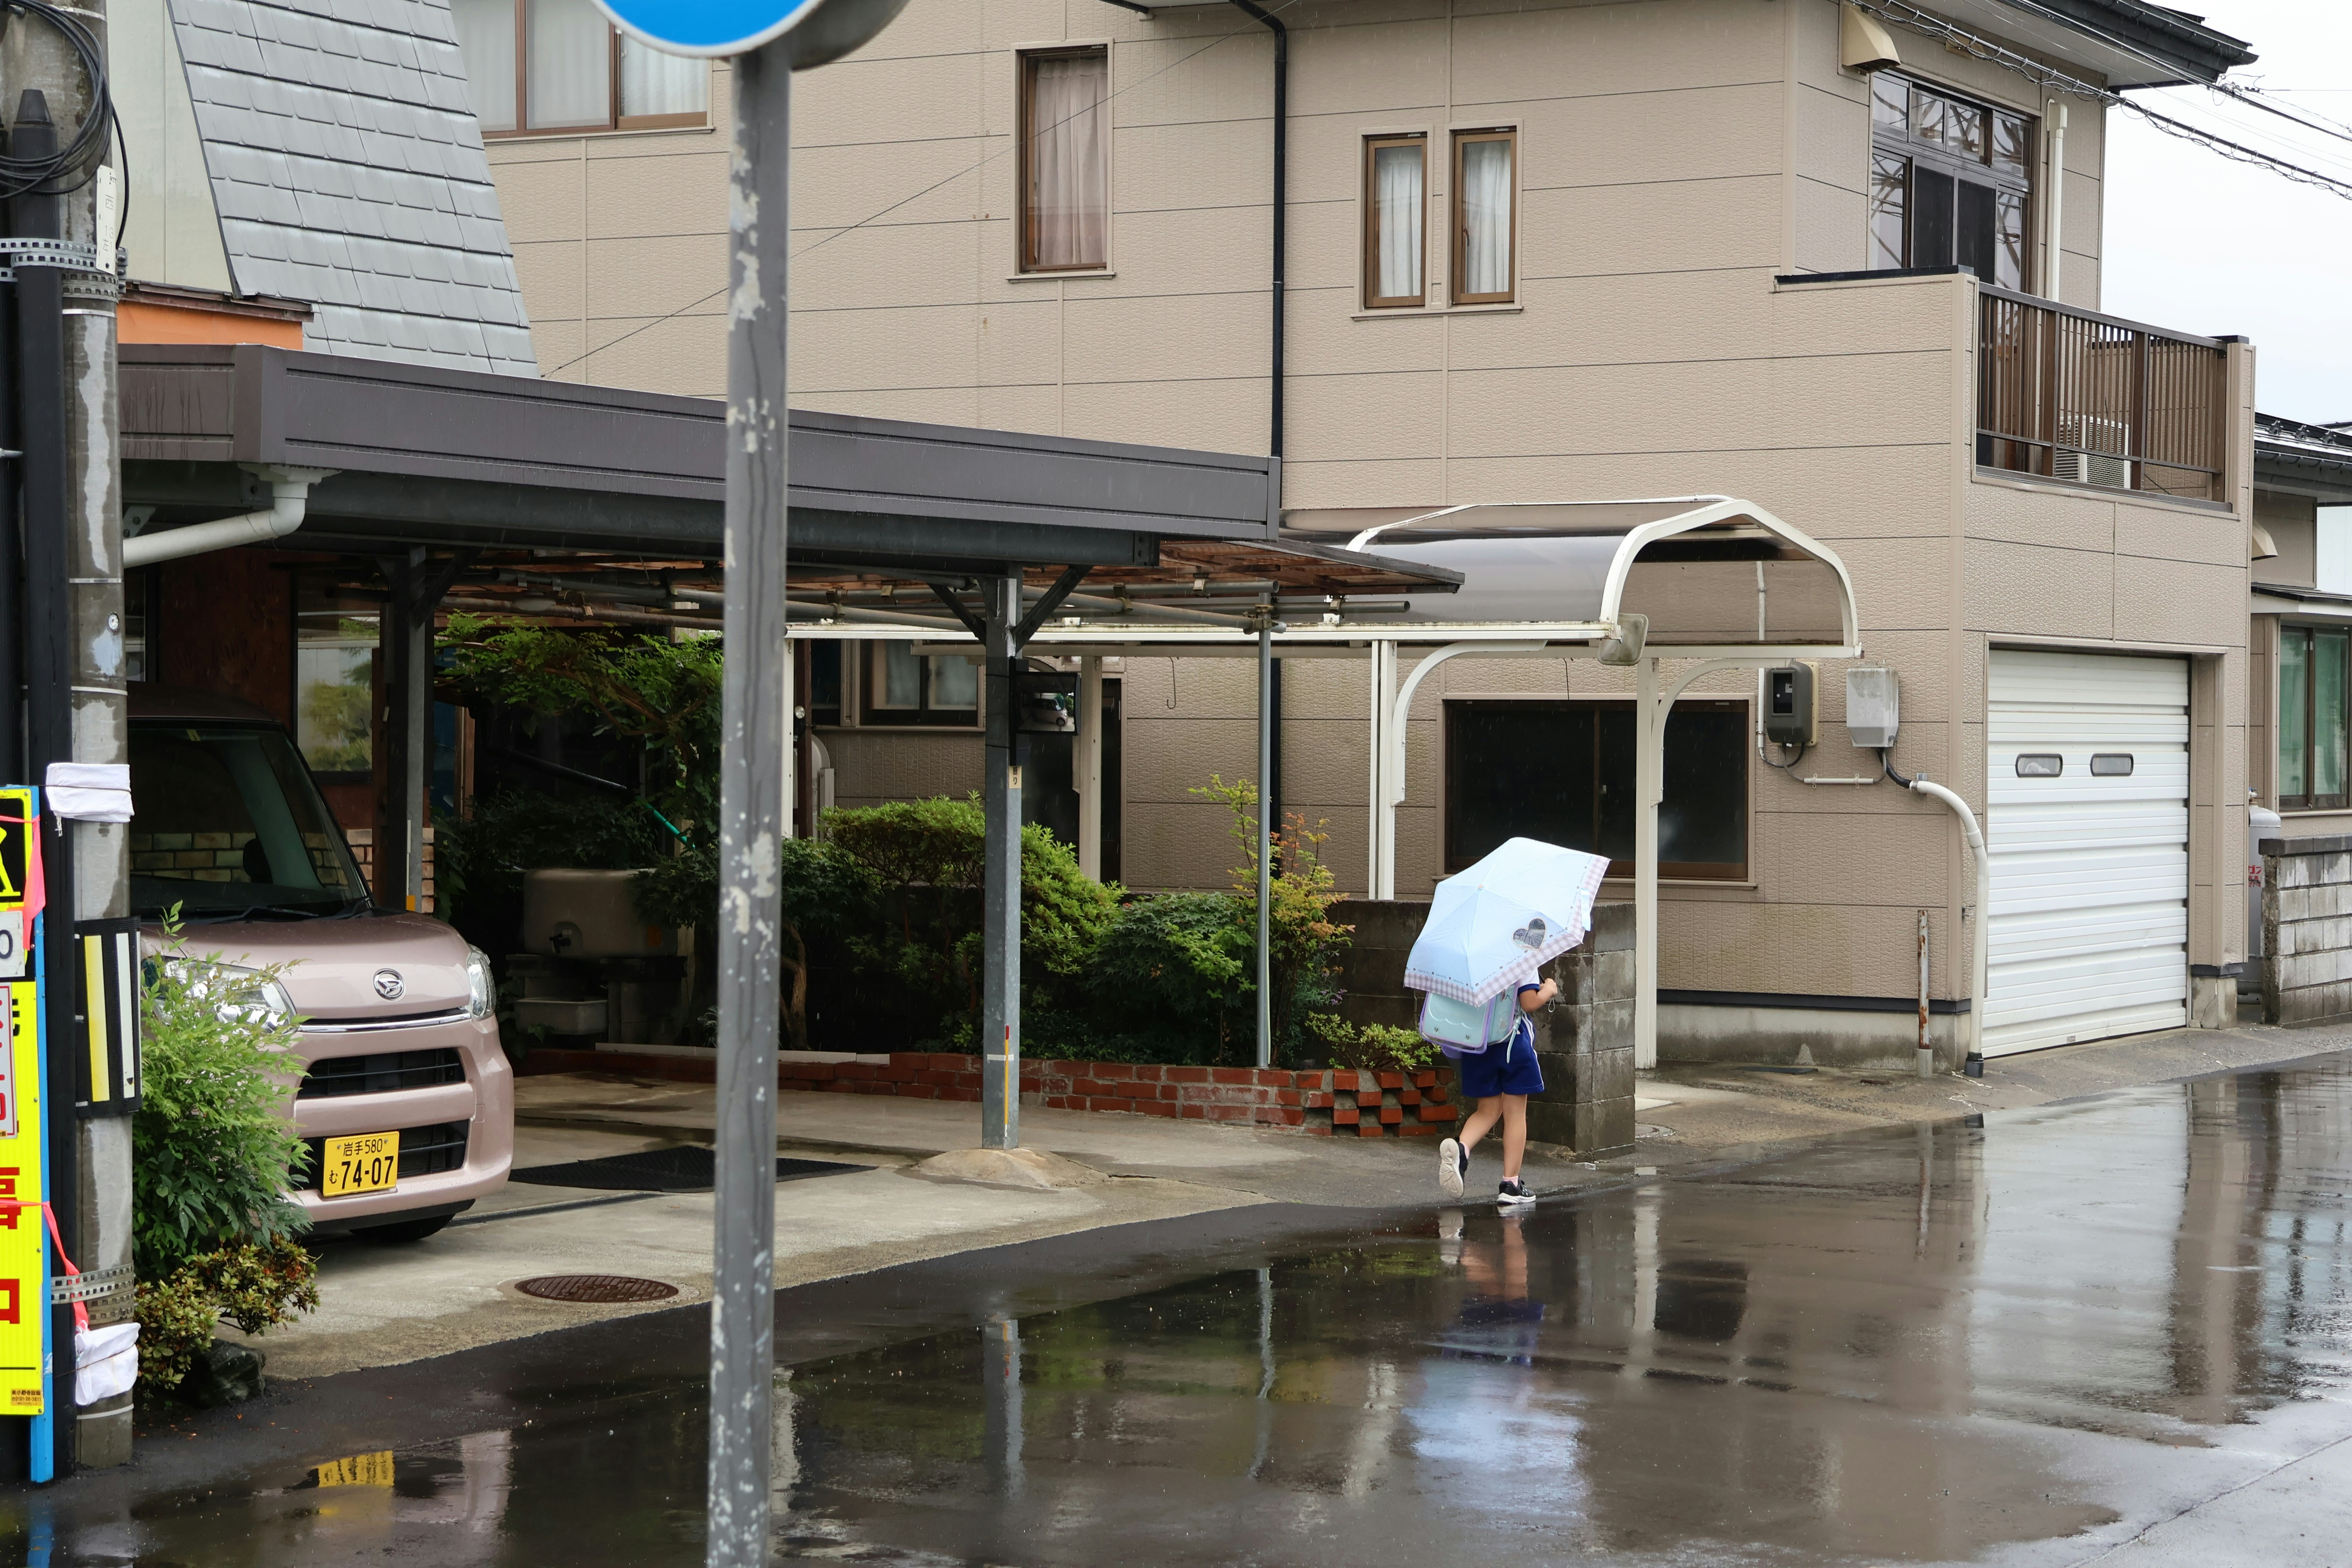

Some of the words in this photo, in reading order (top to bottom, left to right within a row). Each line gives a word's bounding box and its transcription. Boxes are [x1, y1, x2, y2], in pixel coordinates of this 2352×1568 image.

[105, 194, 114, 210] 西
[329, 1170, 338, 1184] む
[341, 1156, 394, 1189] 74-07
